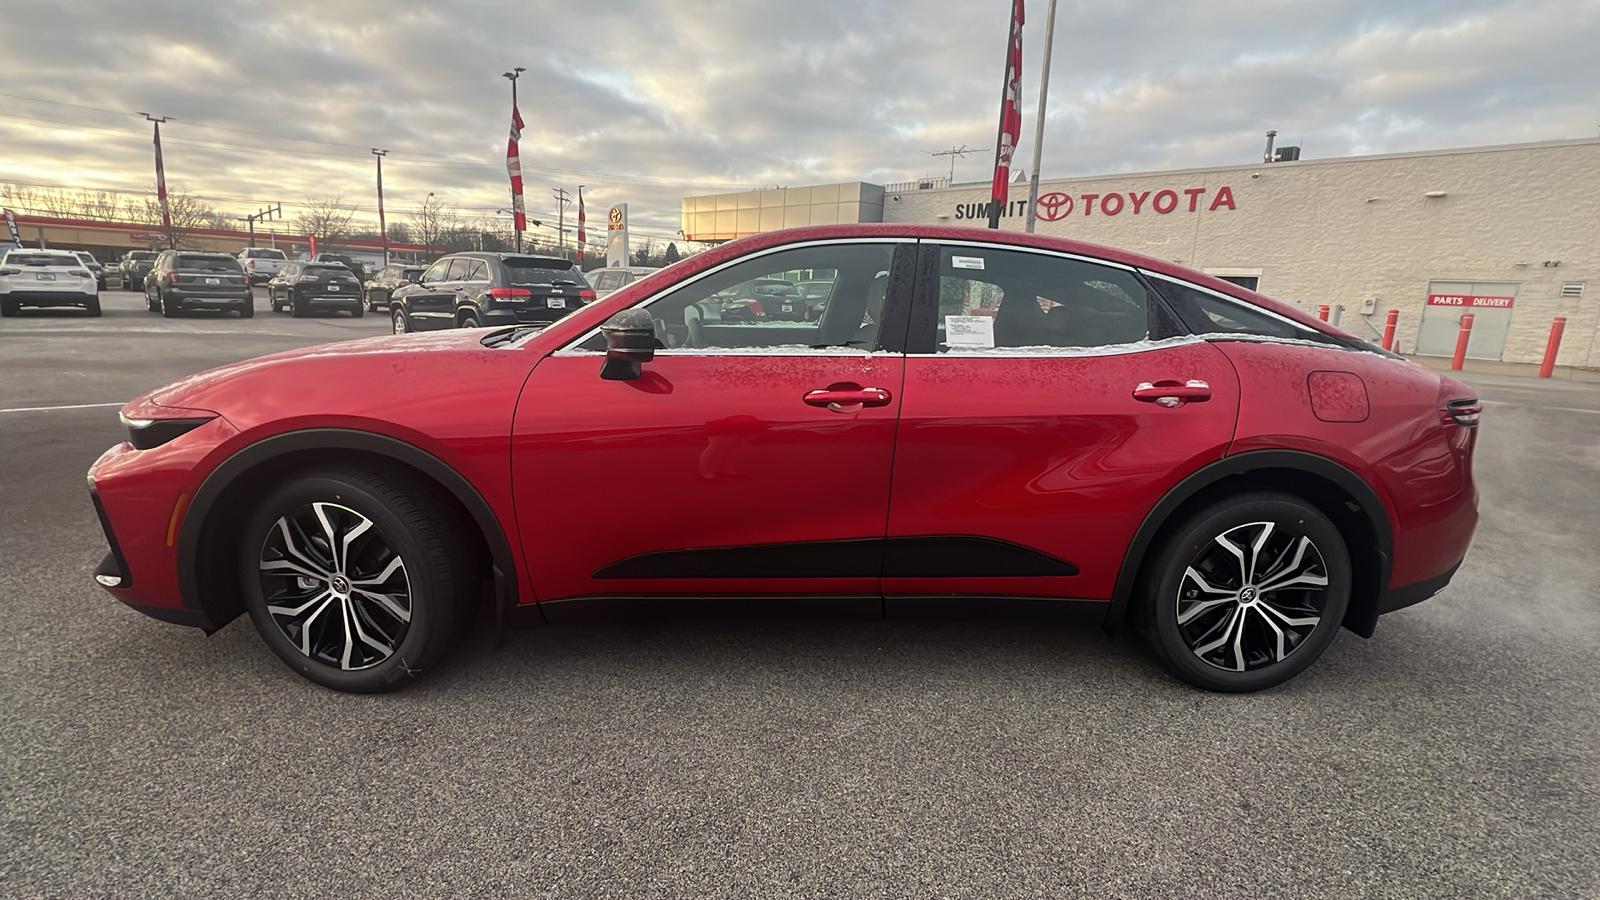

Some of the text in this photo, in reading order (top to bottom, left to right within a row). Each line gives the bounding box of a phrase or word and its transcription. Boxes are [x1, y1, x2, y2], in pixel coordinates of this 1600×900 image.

[1081, 186, 1236, 216] TOYOTA
[1433, 296, 1510, 307] PARTS DELIVERY
